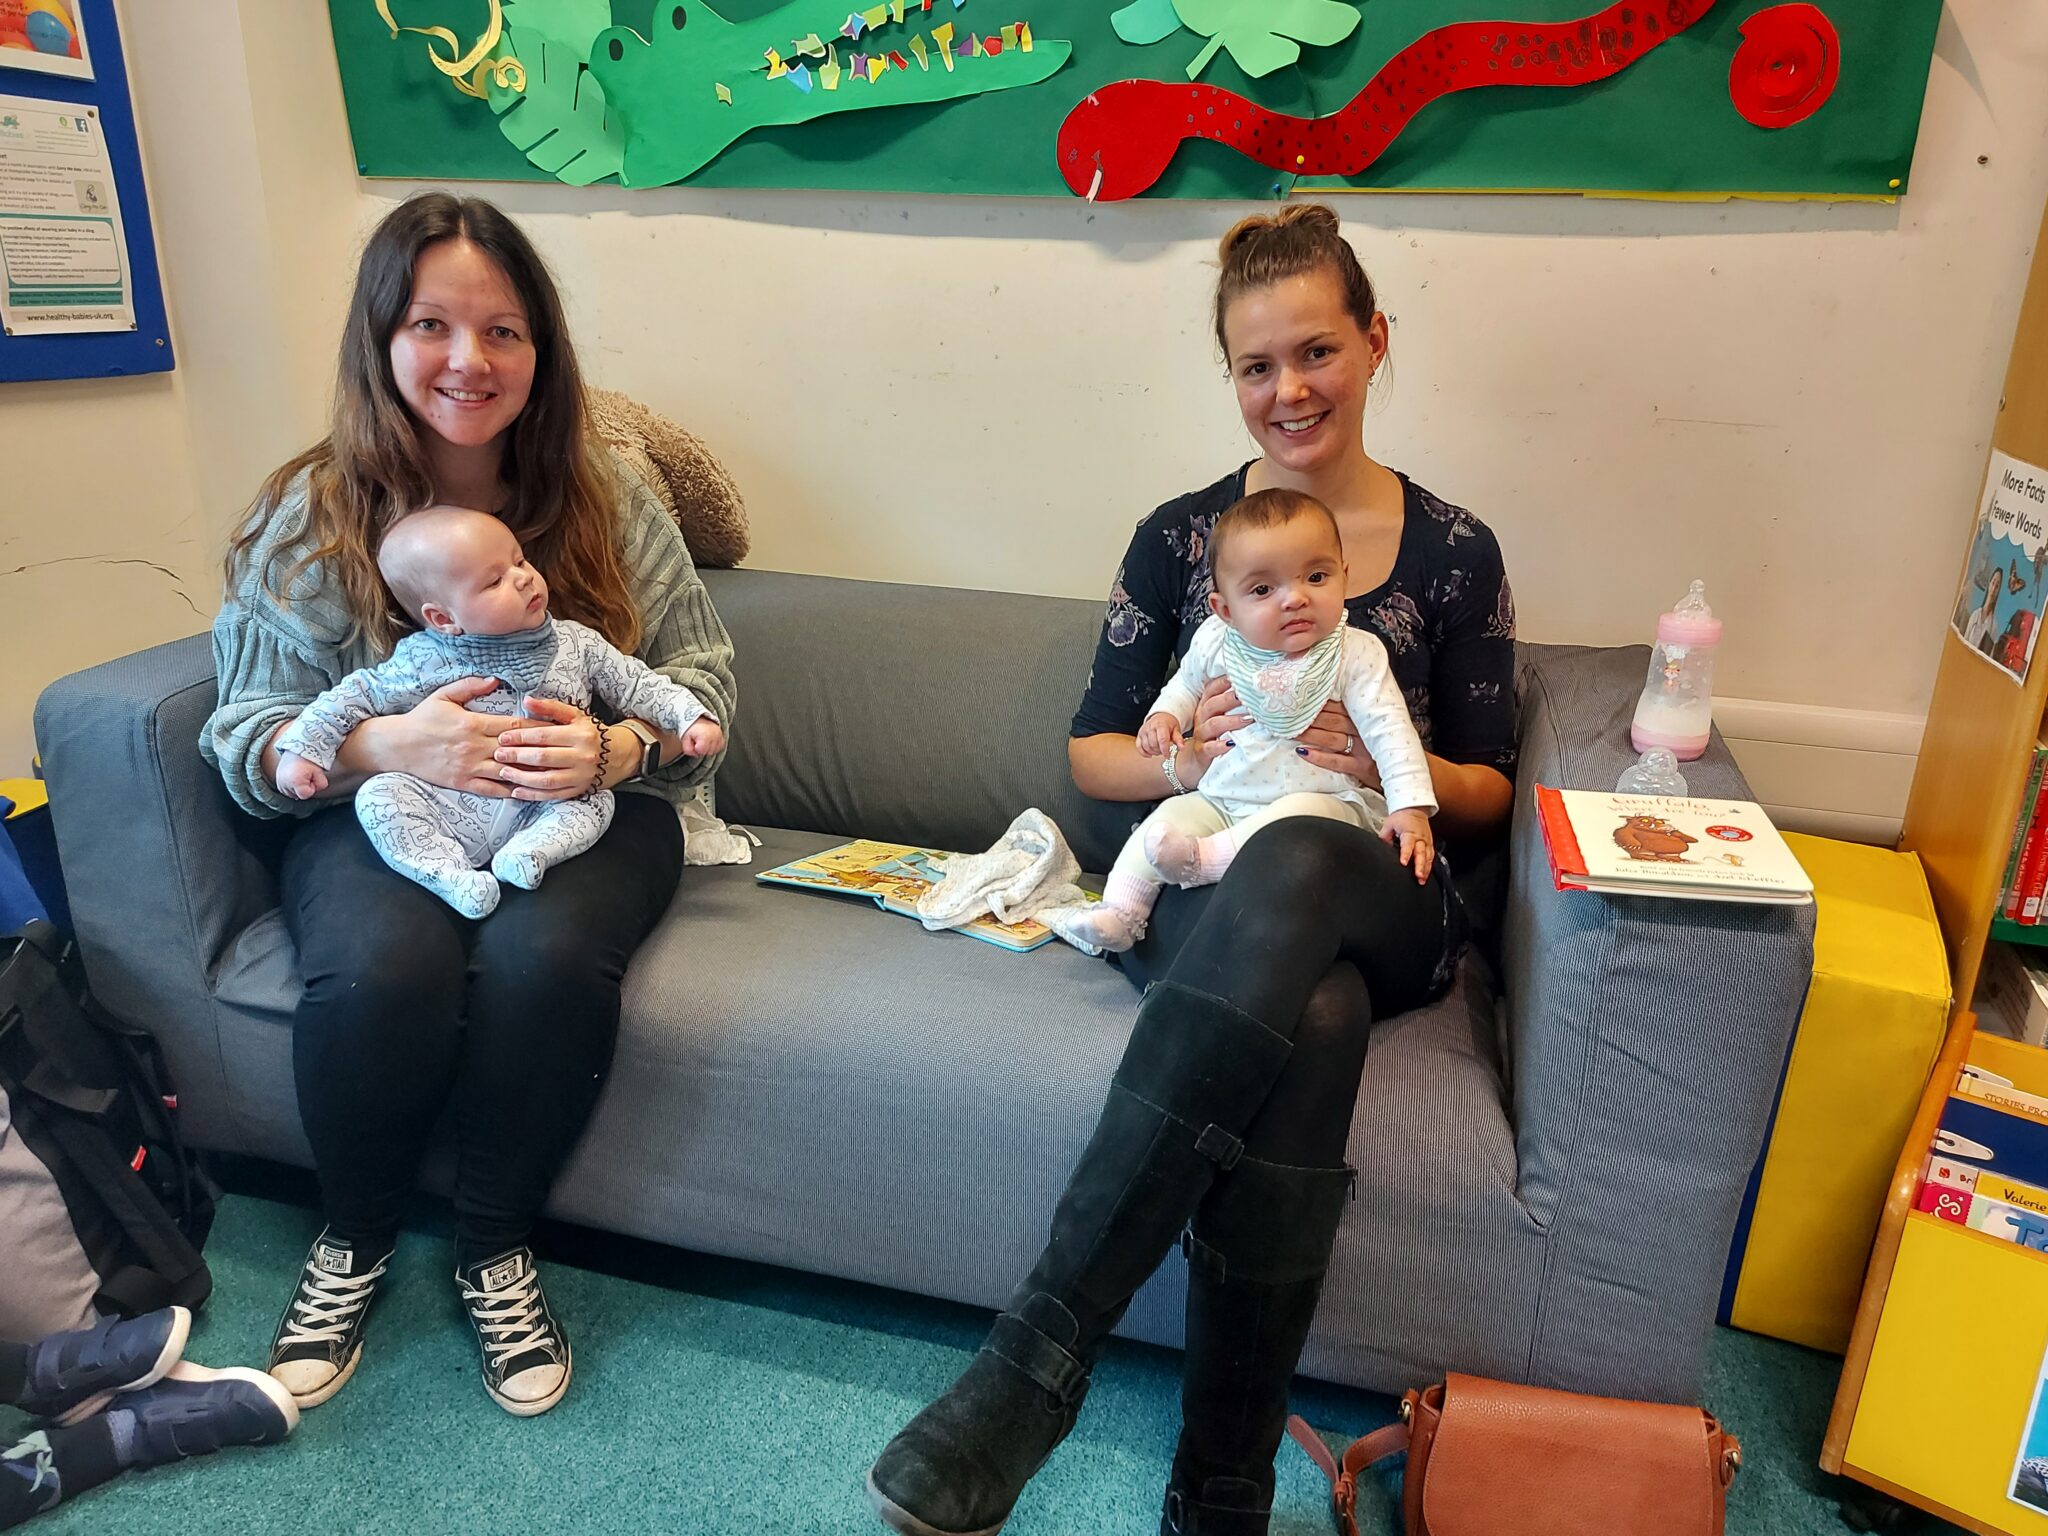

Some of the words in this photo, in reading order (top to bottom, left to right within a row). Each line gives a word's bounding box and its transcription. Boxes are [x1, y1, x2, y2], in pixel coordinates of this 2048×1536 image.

[26, 312, 115, 321] www.healthy-babies-uk.org
[2001, 469, 2024, 494] More
[2024, 477, 2046, 504] Facts
[2015, 510, 2042, 539] Words
[1984, 1092, 2026, 1112] STORIES
[2004, 1188, 2048, 1212] Valerie
